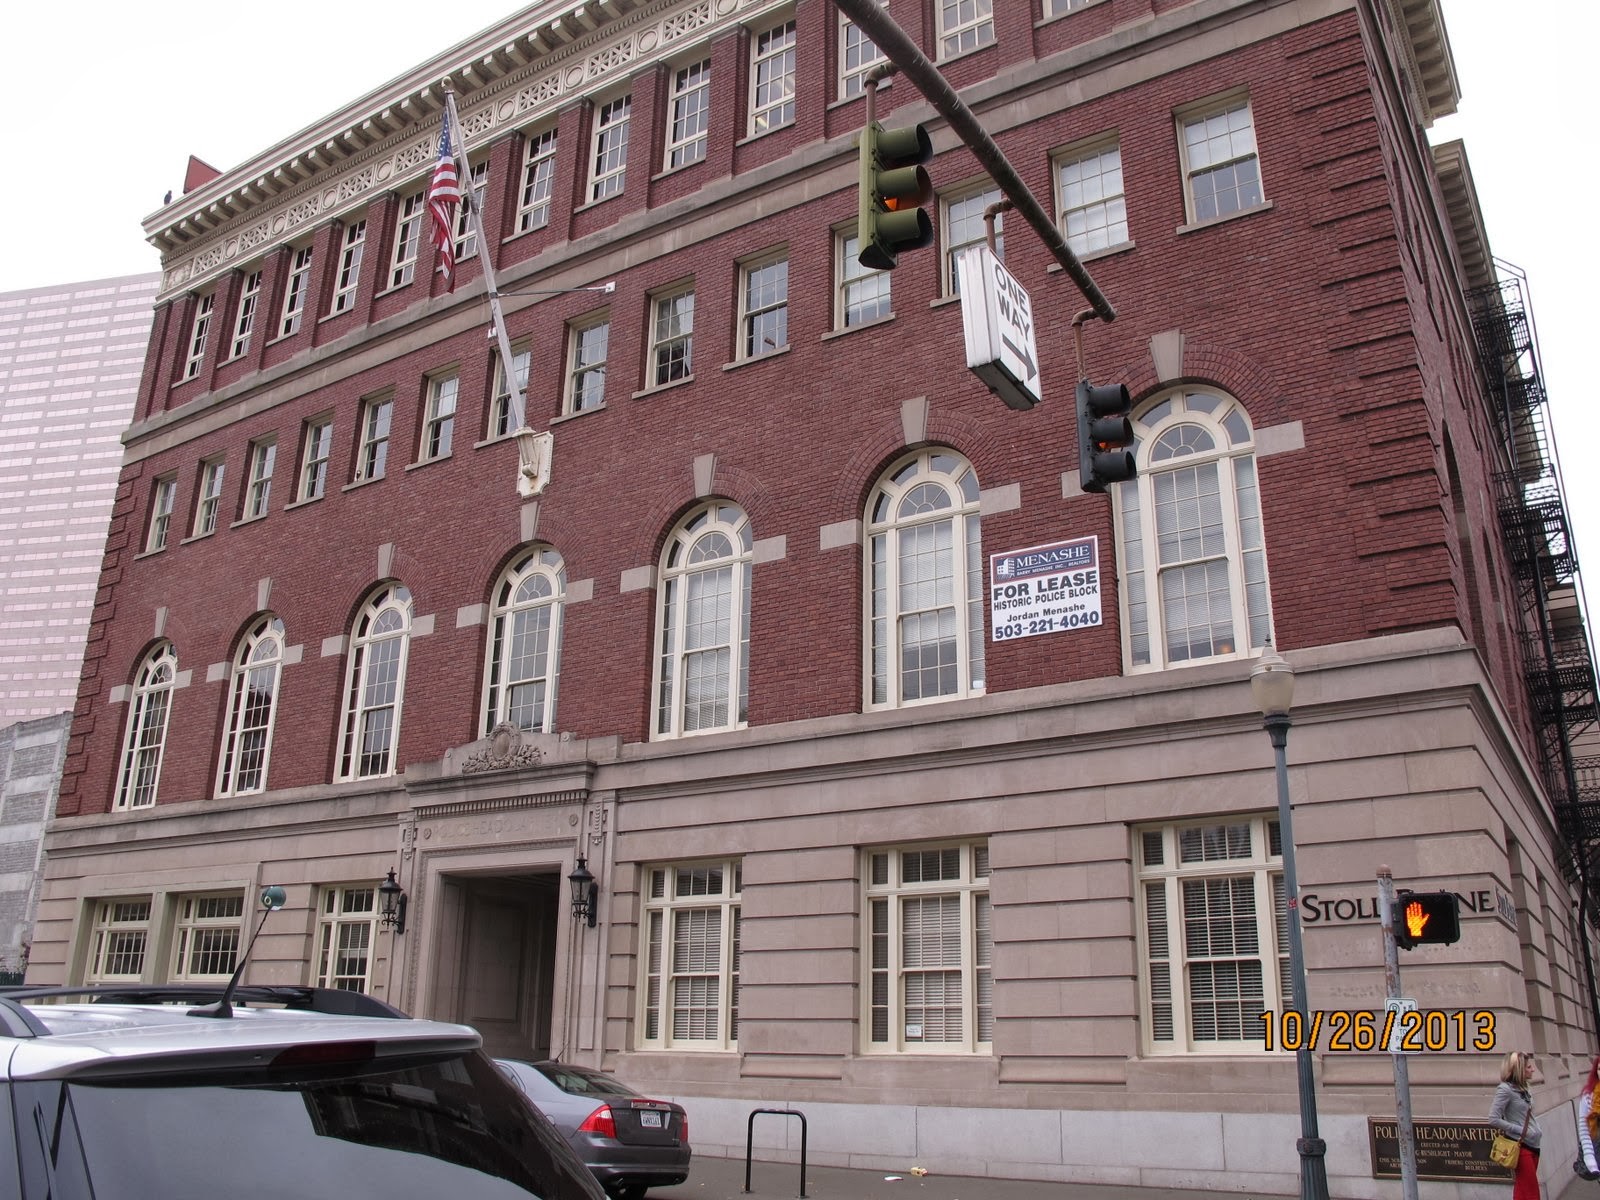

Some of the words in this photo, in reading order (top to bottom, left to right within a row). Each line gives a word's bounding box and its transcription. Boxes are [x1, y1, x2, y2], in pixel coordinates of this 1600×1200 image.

[995, 263, 1029, 317] ONE
[997, 289, 1030, 342] WAY
[1016, 545, 1090, 568] MENASHE
[1032, 565, 1053, 573] MENASHE
[1068, 559, 1090, 567] REALTORS
[993, 582, 1029, 601] FOR
[1037, 570, 1097, 593] LEASE
[993, 596, 1032, 611] HISTORIC
[1035, 590, 1065, 604] POLICE
[1068, 584, 1098, 599] BLOCK
[995, 610, 1100, 639] 503-221-4040
[1006, 610, 1039, 622] Jordan
[1043, 603, 1086, 616] Menashe
[1301, 894, 1381, 922] STOLL
[1375, 1126, 1400, 1139] POLI
